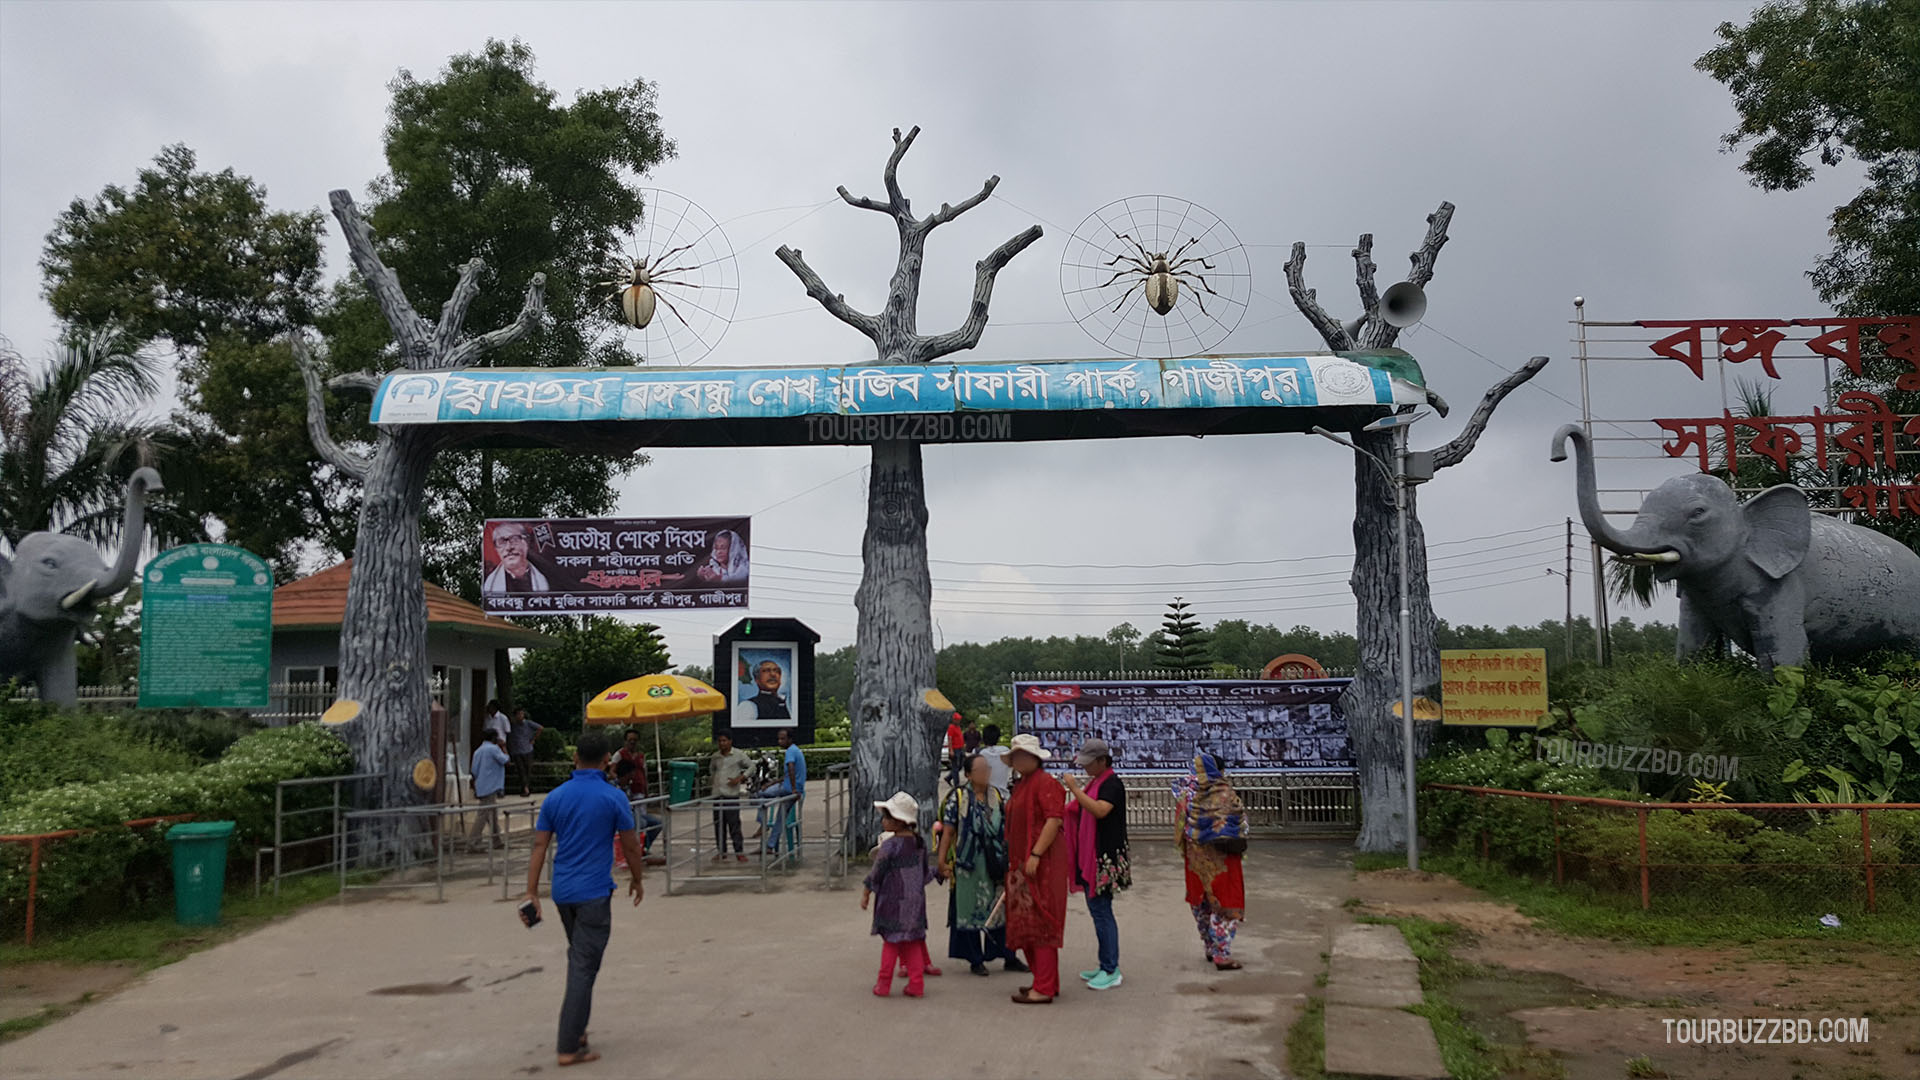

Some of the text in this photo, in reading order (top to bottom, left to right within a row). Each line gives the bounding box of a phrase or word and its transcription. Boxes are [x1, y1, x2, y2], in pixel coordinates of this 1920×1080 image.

[626, 380, 736, 417] বঙ্গবন্ধু
[748, 374, 820, 406] শেখ
[830, 369, 923, 412] মুজিব
[933, 366, 1051, 401] সাফারী
[1064, 362, 1150, 406] পার্ক,
[1162, 362, 1301, 403] গাজীপুর
[1651, 390, 1903, 475] সাফারী
[557, 525, 708, 551] জাতীয় শোক দিবস
[555, 550, 697, 568] সকল শহীদদের প্রতি
[528, 595, 552, 608] শেখ
[555, 594, 585, 609] মুজিব
[589, 592, 627, 607] সাফারি
[630, 592, 657, 607] পার্ক,
[661, 591, 696, 608] শ্রীপুর,
[699, 590, 742, 606] গাজীপুর
[1154, 686, 1220, 696] জাতীয়
[1230, 686, 1281, 696] শোক
[1289, 684, 1344, 695] দিবস
